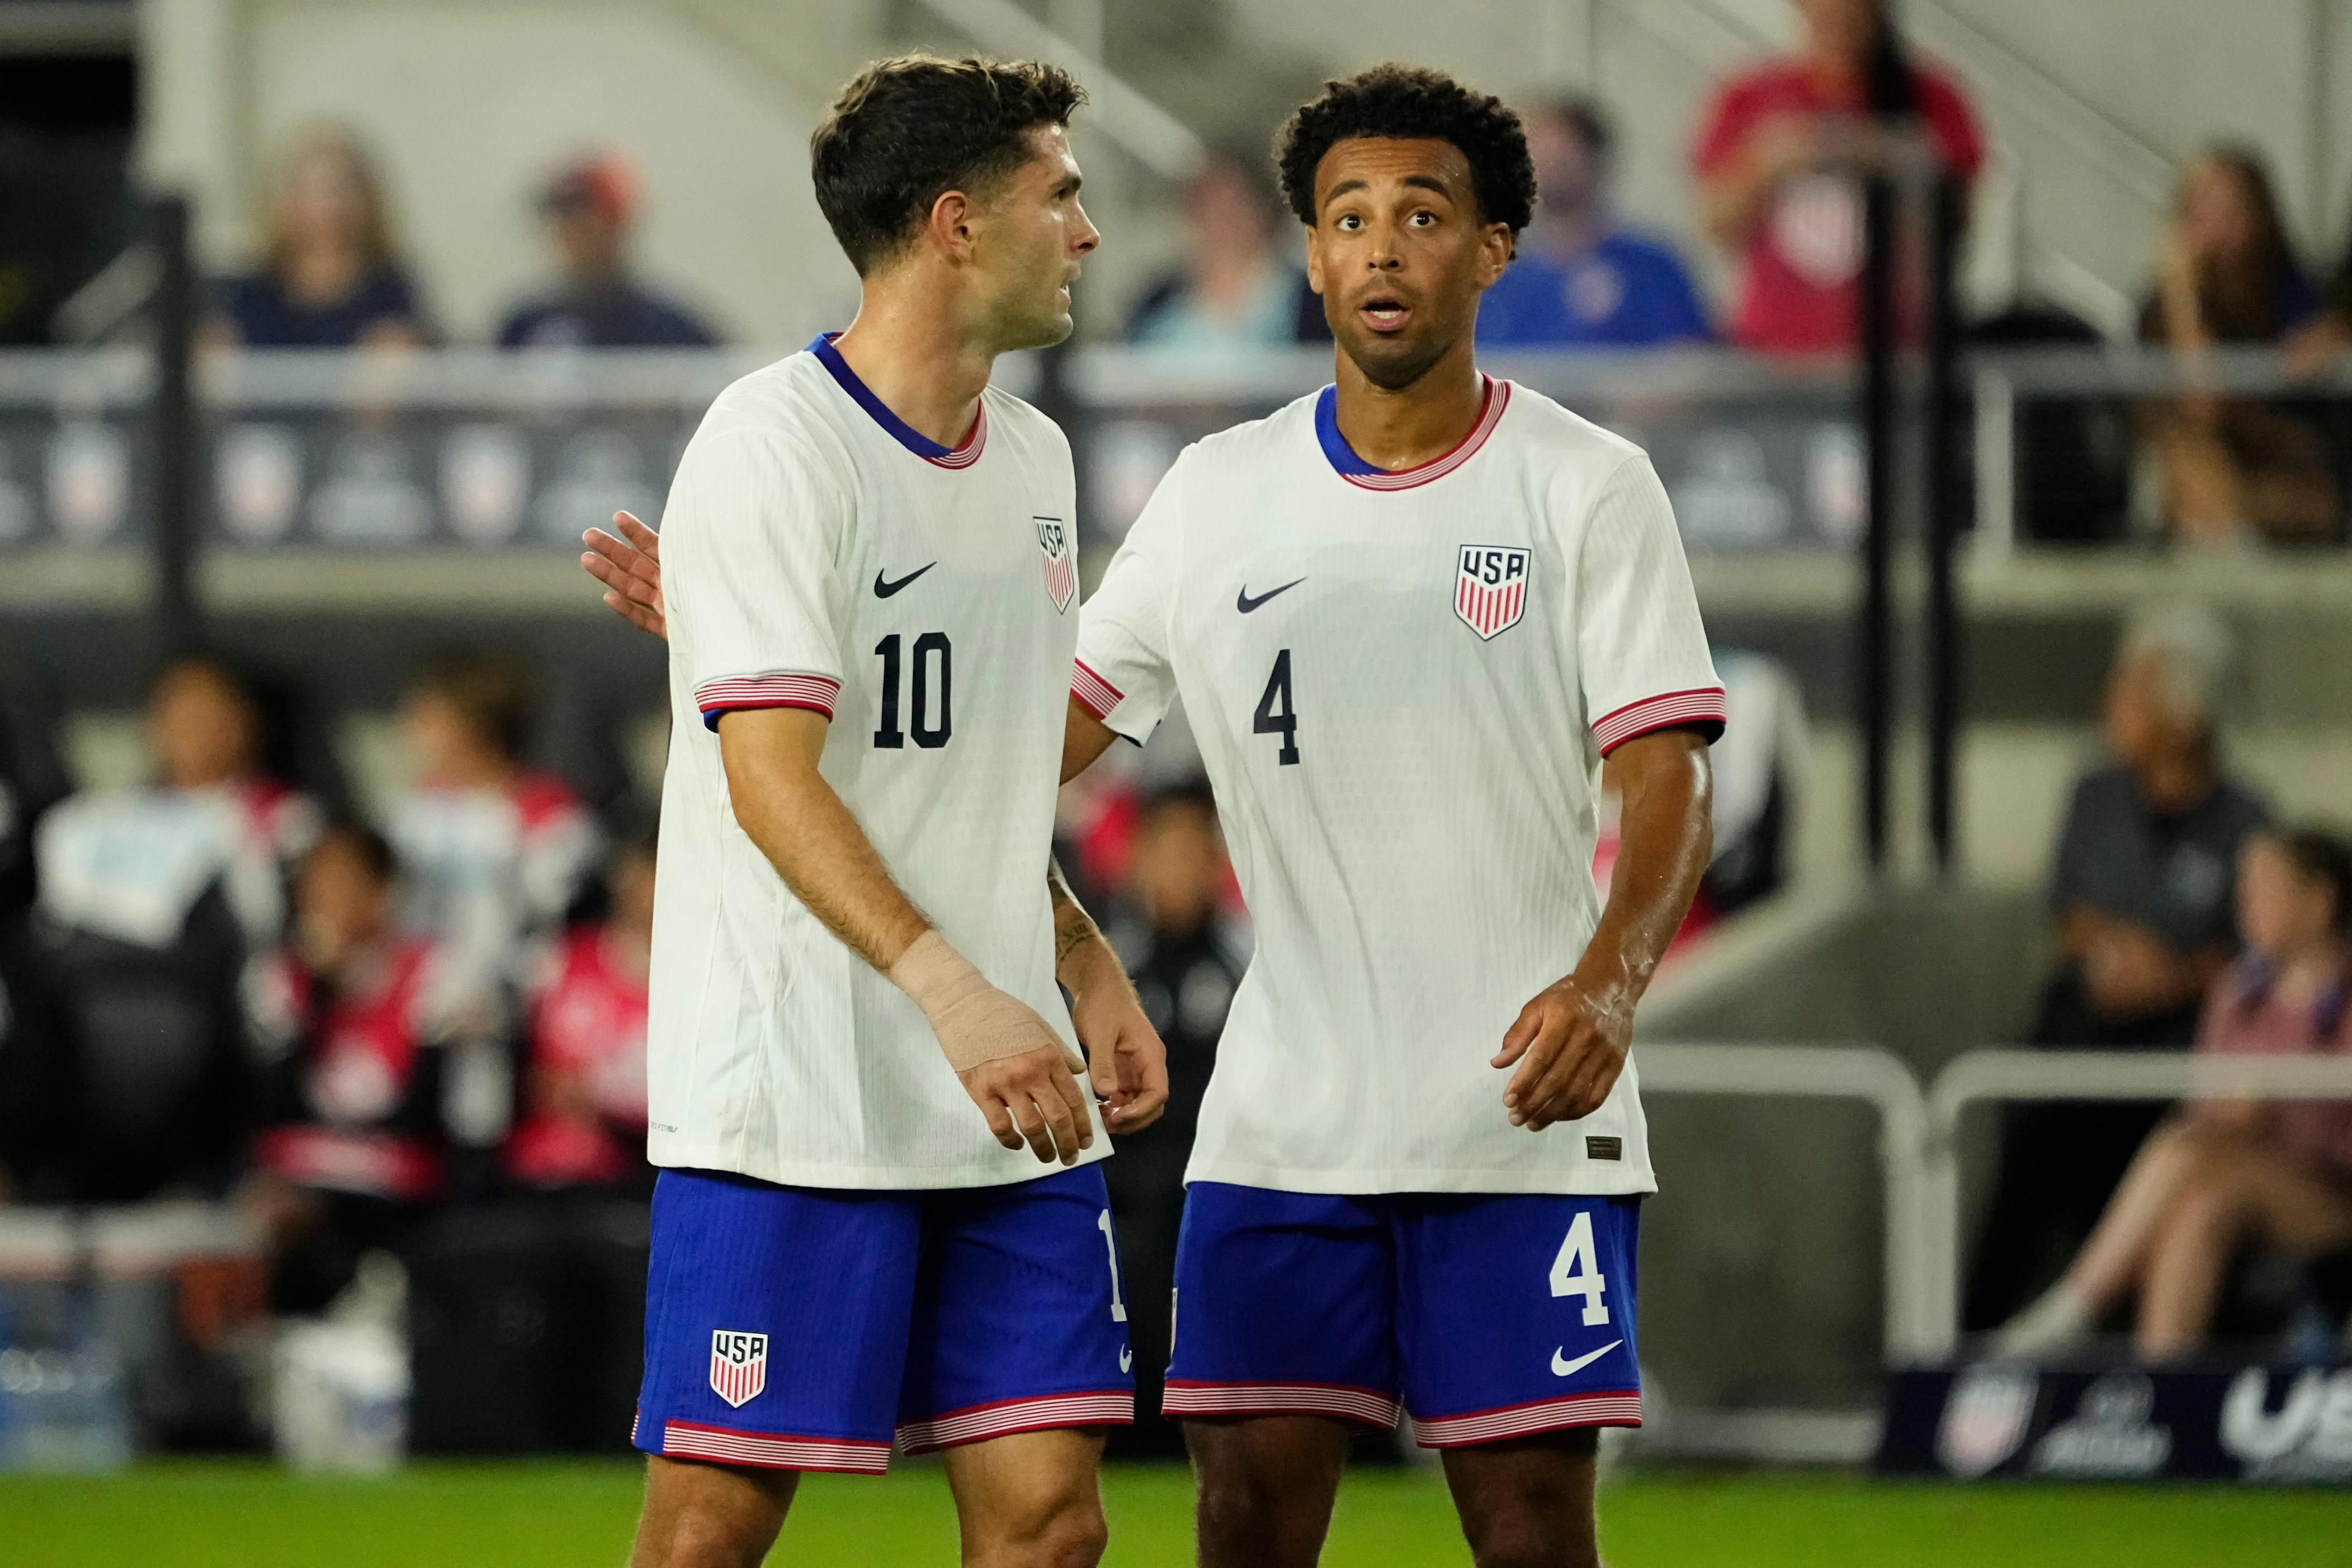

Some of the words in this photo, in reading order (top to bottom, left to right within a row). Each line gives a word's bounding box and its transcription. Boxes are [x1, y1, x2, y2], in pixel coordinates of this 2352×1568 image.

[1037, 523, 1065, 558] USA
[1463, 551, 1524, 585] USA
[873, 631, 952, 749] 10
[1253, 649, 1300, 766] 4
[1098, 1208, 1127, 1322] 1
[1549, 1211, 1609, 1326] 4
[716, 1334, 764, 1364] USA
